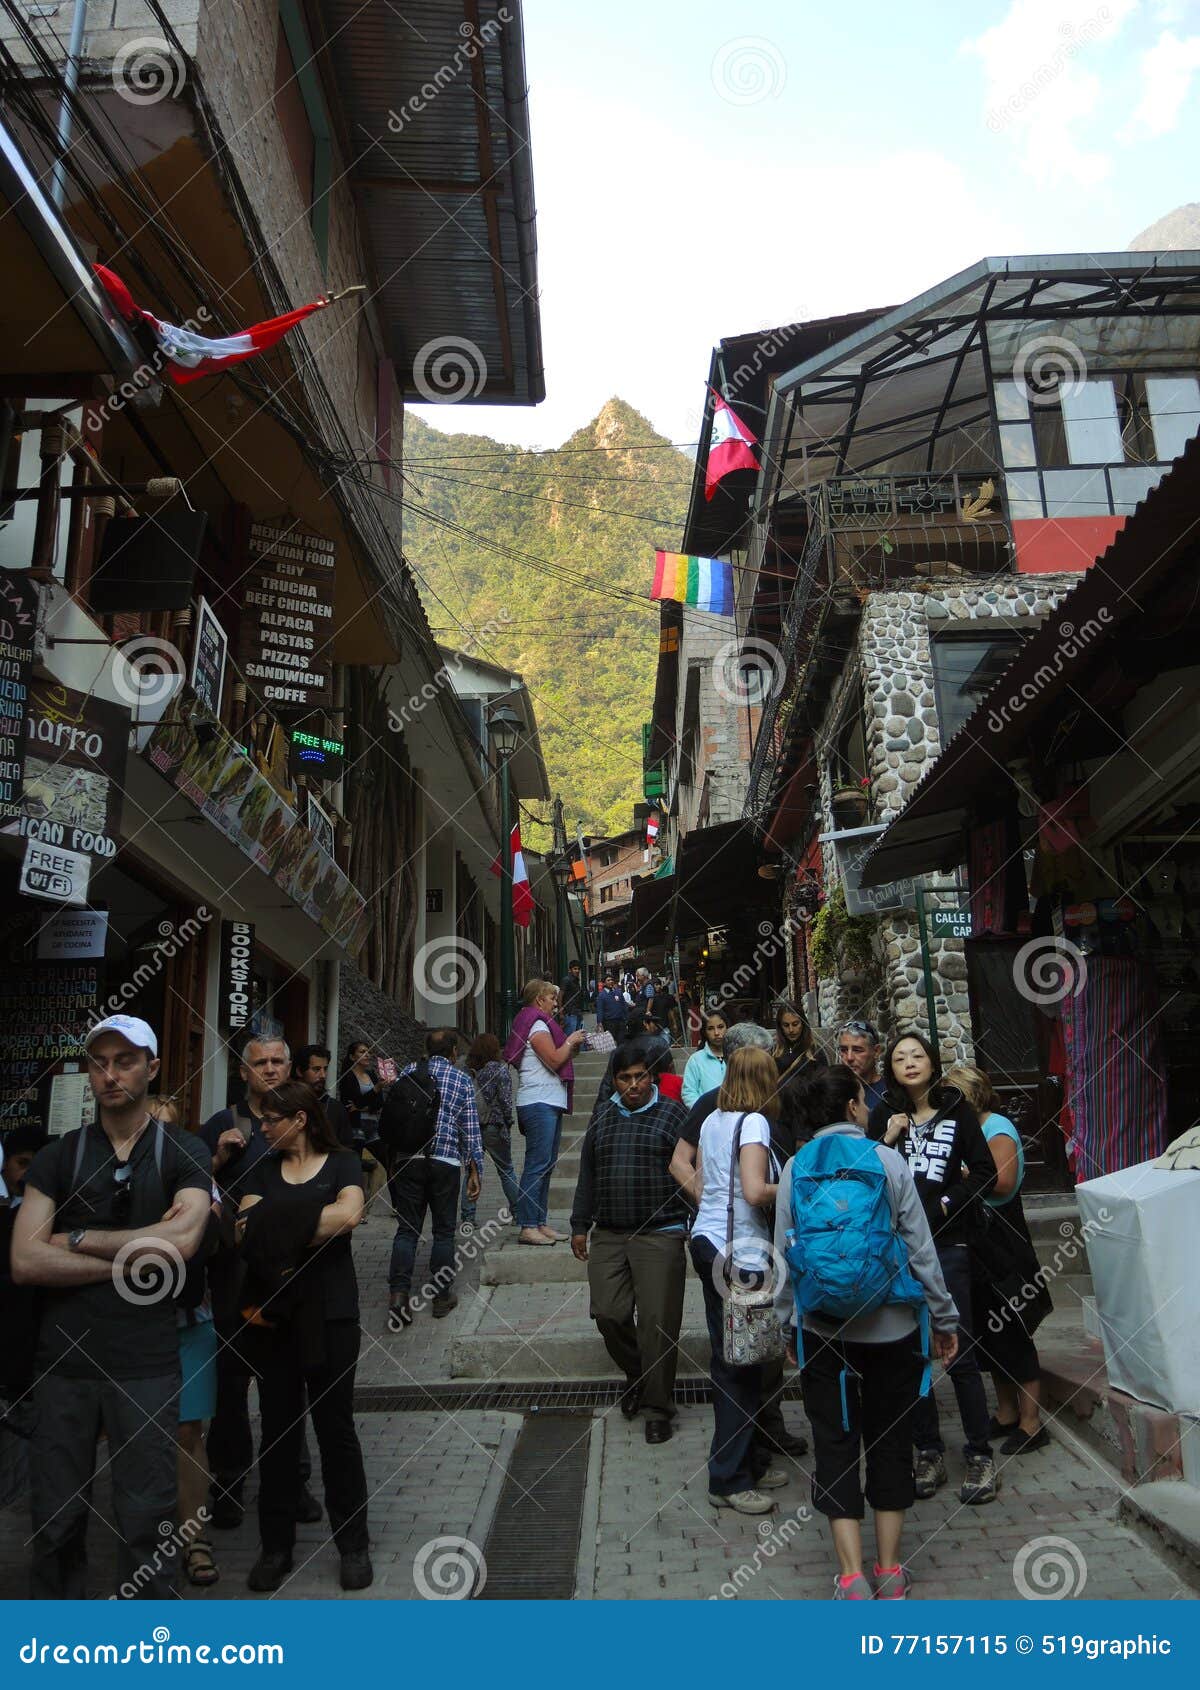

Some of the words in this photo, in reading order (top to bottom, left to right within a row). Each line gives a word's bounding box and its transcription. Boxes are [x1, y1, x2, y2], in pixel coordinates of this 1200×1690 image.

[250, 523, 303, 546] MEXICAN
[304, 535, 334, 553] FOOD
[248, 537, 304, 562] PERUVIAN
[305, 549, 335, 568] FOOD
[276, 562, 305, 577] CUY
[262, 576, 317, 599] TRUCHA
[245, 590, 276, 609] BEEF
[277, 596, 332, 619] CHICKEN
[260, 611, 314, 632] ALPACA
[260, 629, 314, 650] PASTAS
[262, 648, 309, 669] PIZZAS
[245, 662, 325, 687] SANDWICH
[264, 684, 307, 703] COFFE
[292, 730, 320, 749] FREE
[321, 738, 345, 757] WIFI
[72, 831, 118, 859] FOOD
[30, 850, 75, 874] FREE
[935, 912, 967, 924] CALLE
[229, 922, 251, 1028] BOOKSTORE
